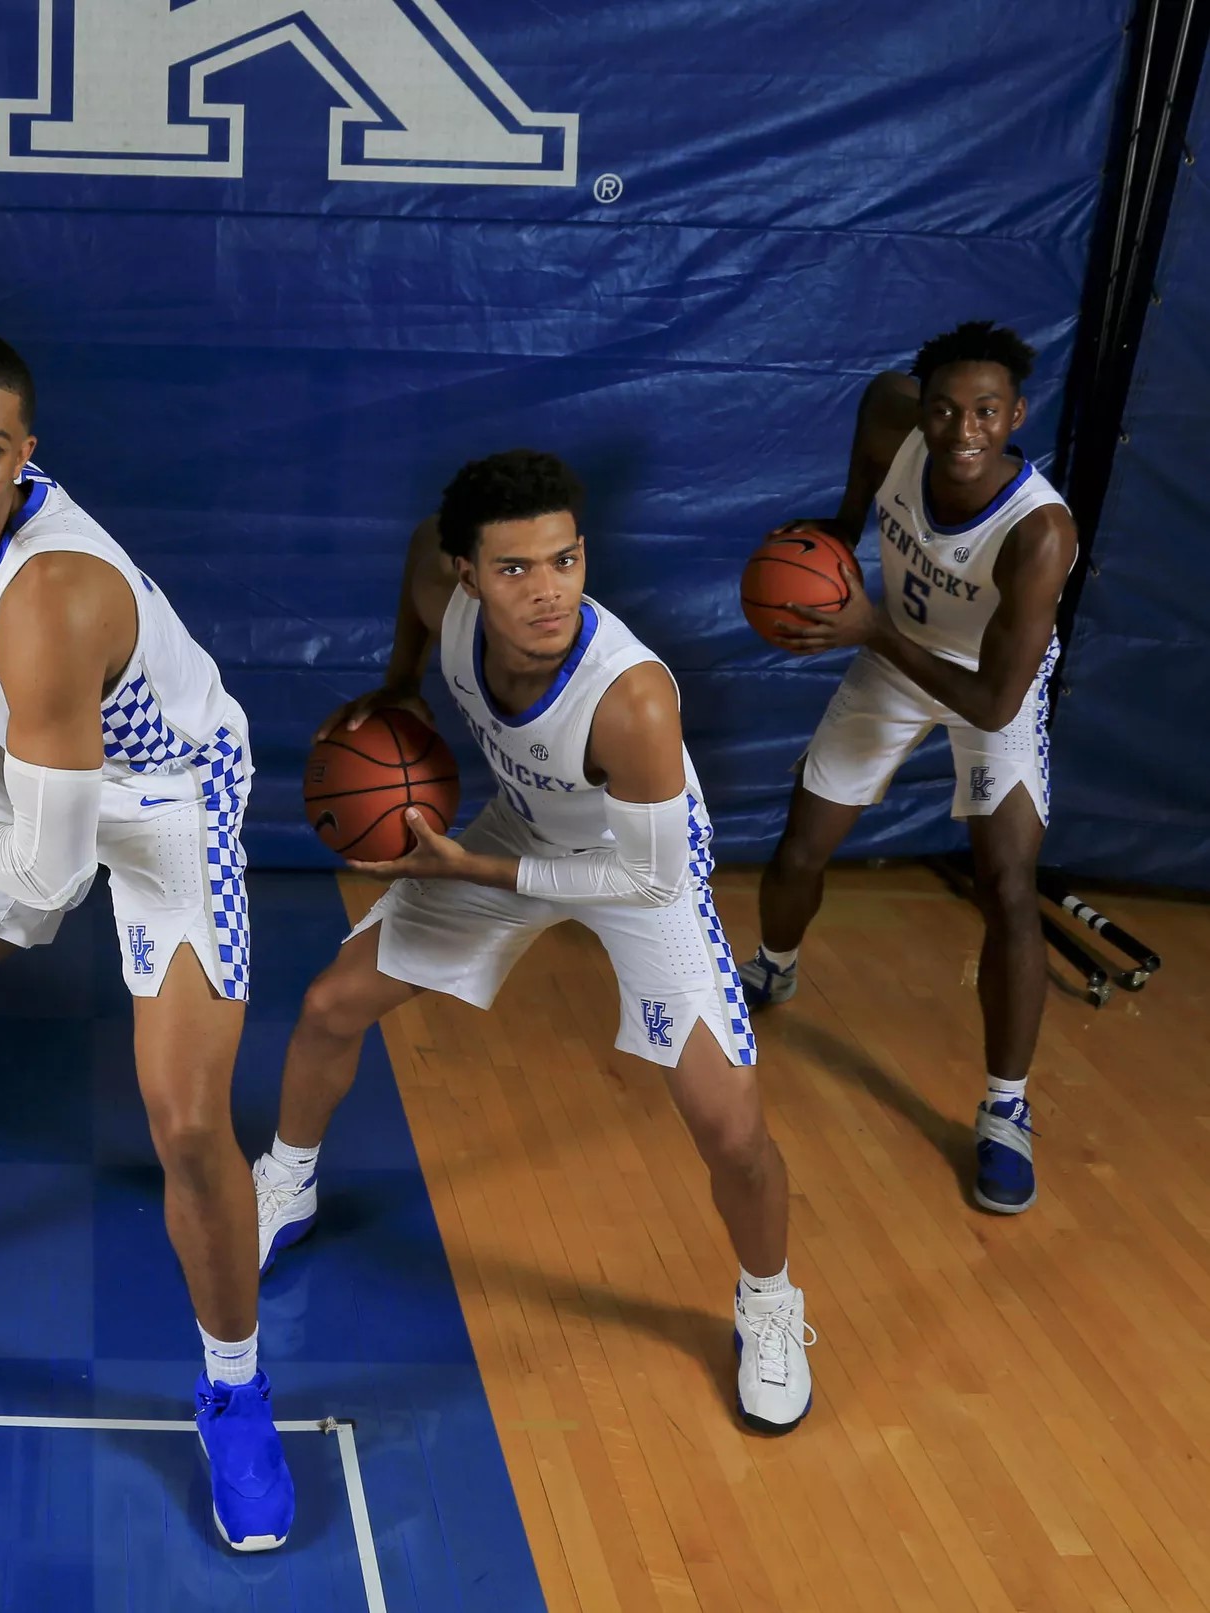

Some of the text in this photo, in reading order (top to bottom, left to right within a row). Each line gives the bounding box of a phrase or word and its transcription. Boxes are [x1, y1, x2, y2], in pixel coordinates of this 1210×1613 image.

[879, 505, 980, 602] KENTUCKY
[902, 568, 931, 625] 5
[127, 925, 154, 974] UK
[640, 998, 673, 1047] UK
